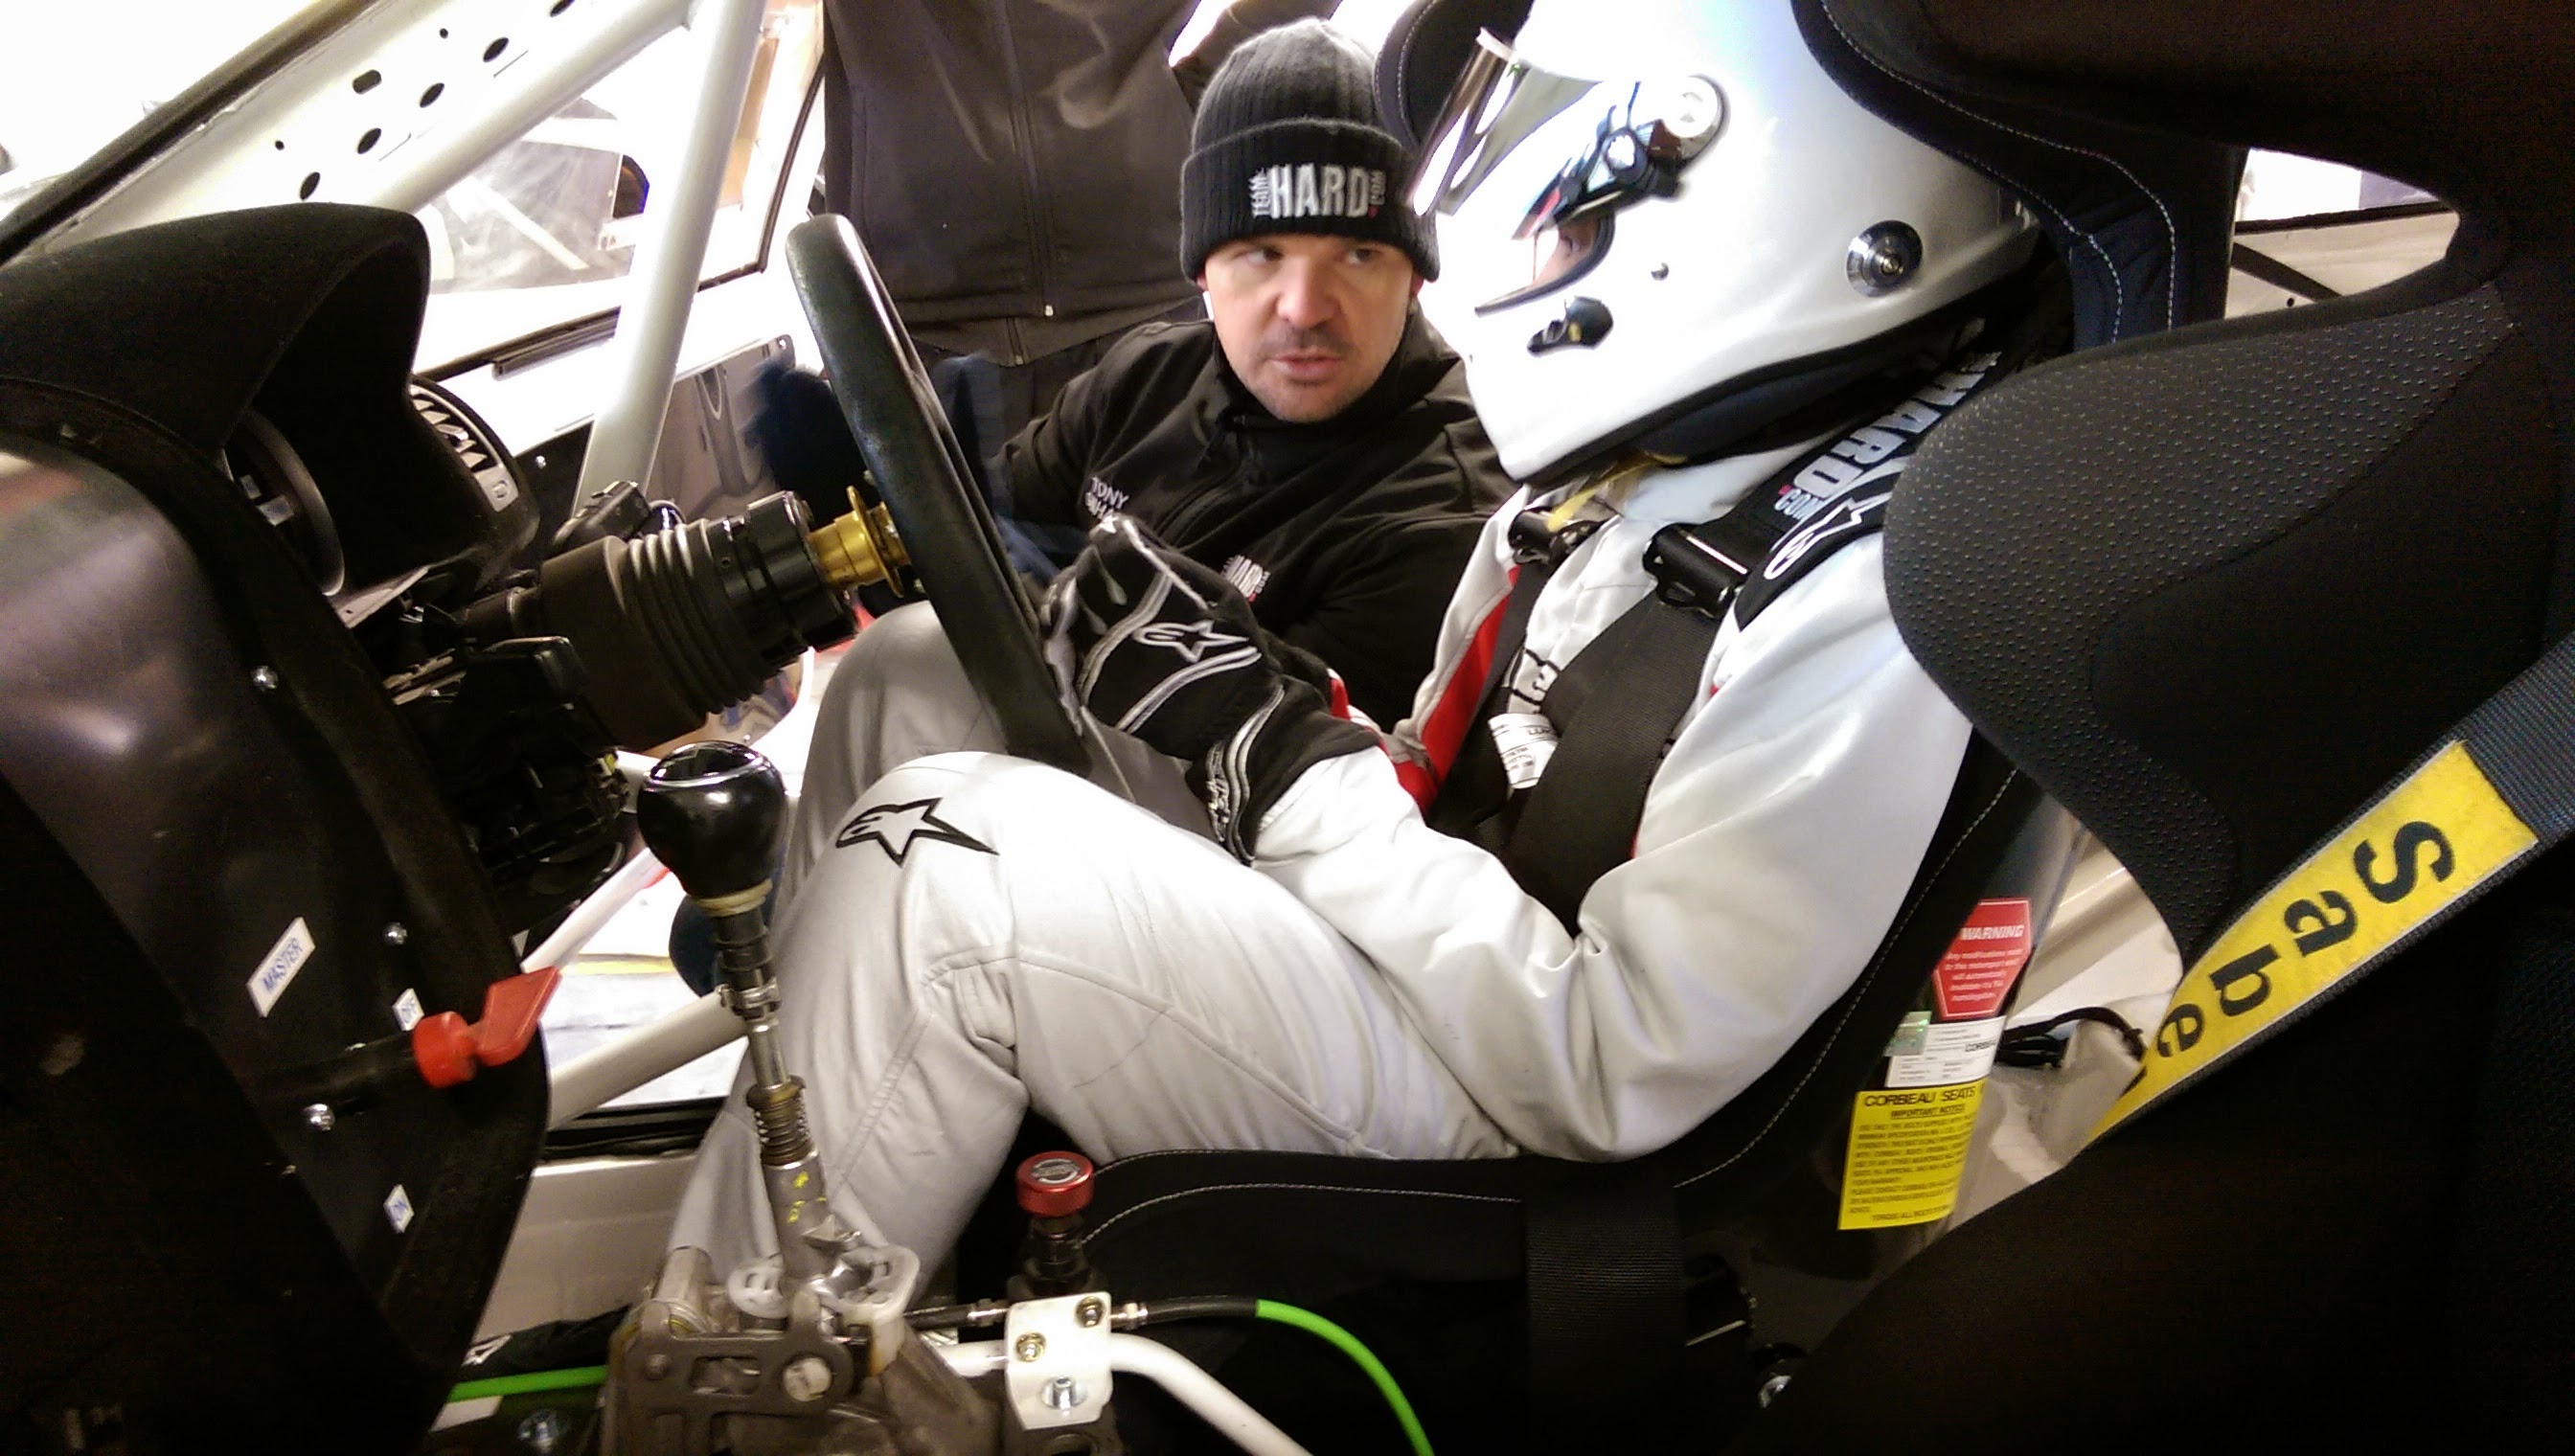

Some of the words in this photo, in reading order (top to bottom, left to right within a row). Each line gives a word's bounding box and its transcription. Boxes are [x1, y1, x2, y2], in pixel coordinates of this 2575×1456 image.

[1268, 163, 1370, 218] HARD
[1793, 372, 1985, 501] HARD
[1091, 477, 1130, 509] TONY
[1960, 924, 2025, 941] WARNING
[262, 938, 304, 993] MASTER
[1864, 1092, 1937, 1107] CORBEAU
[1940, 1085, 1976, 1103] SEATS
[1891, 1107, 1937, 1119] IMPORTANT
